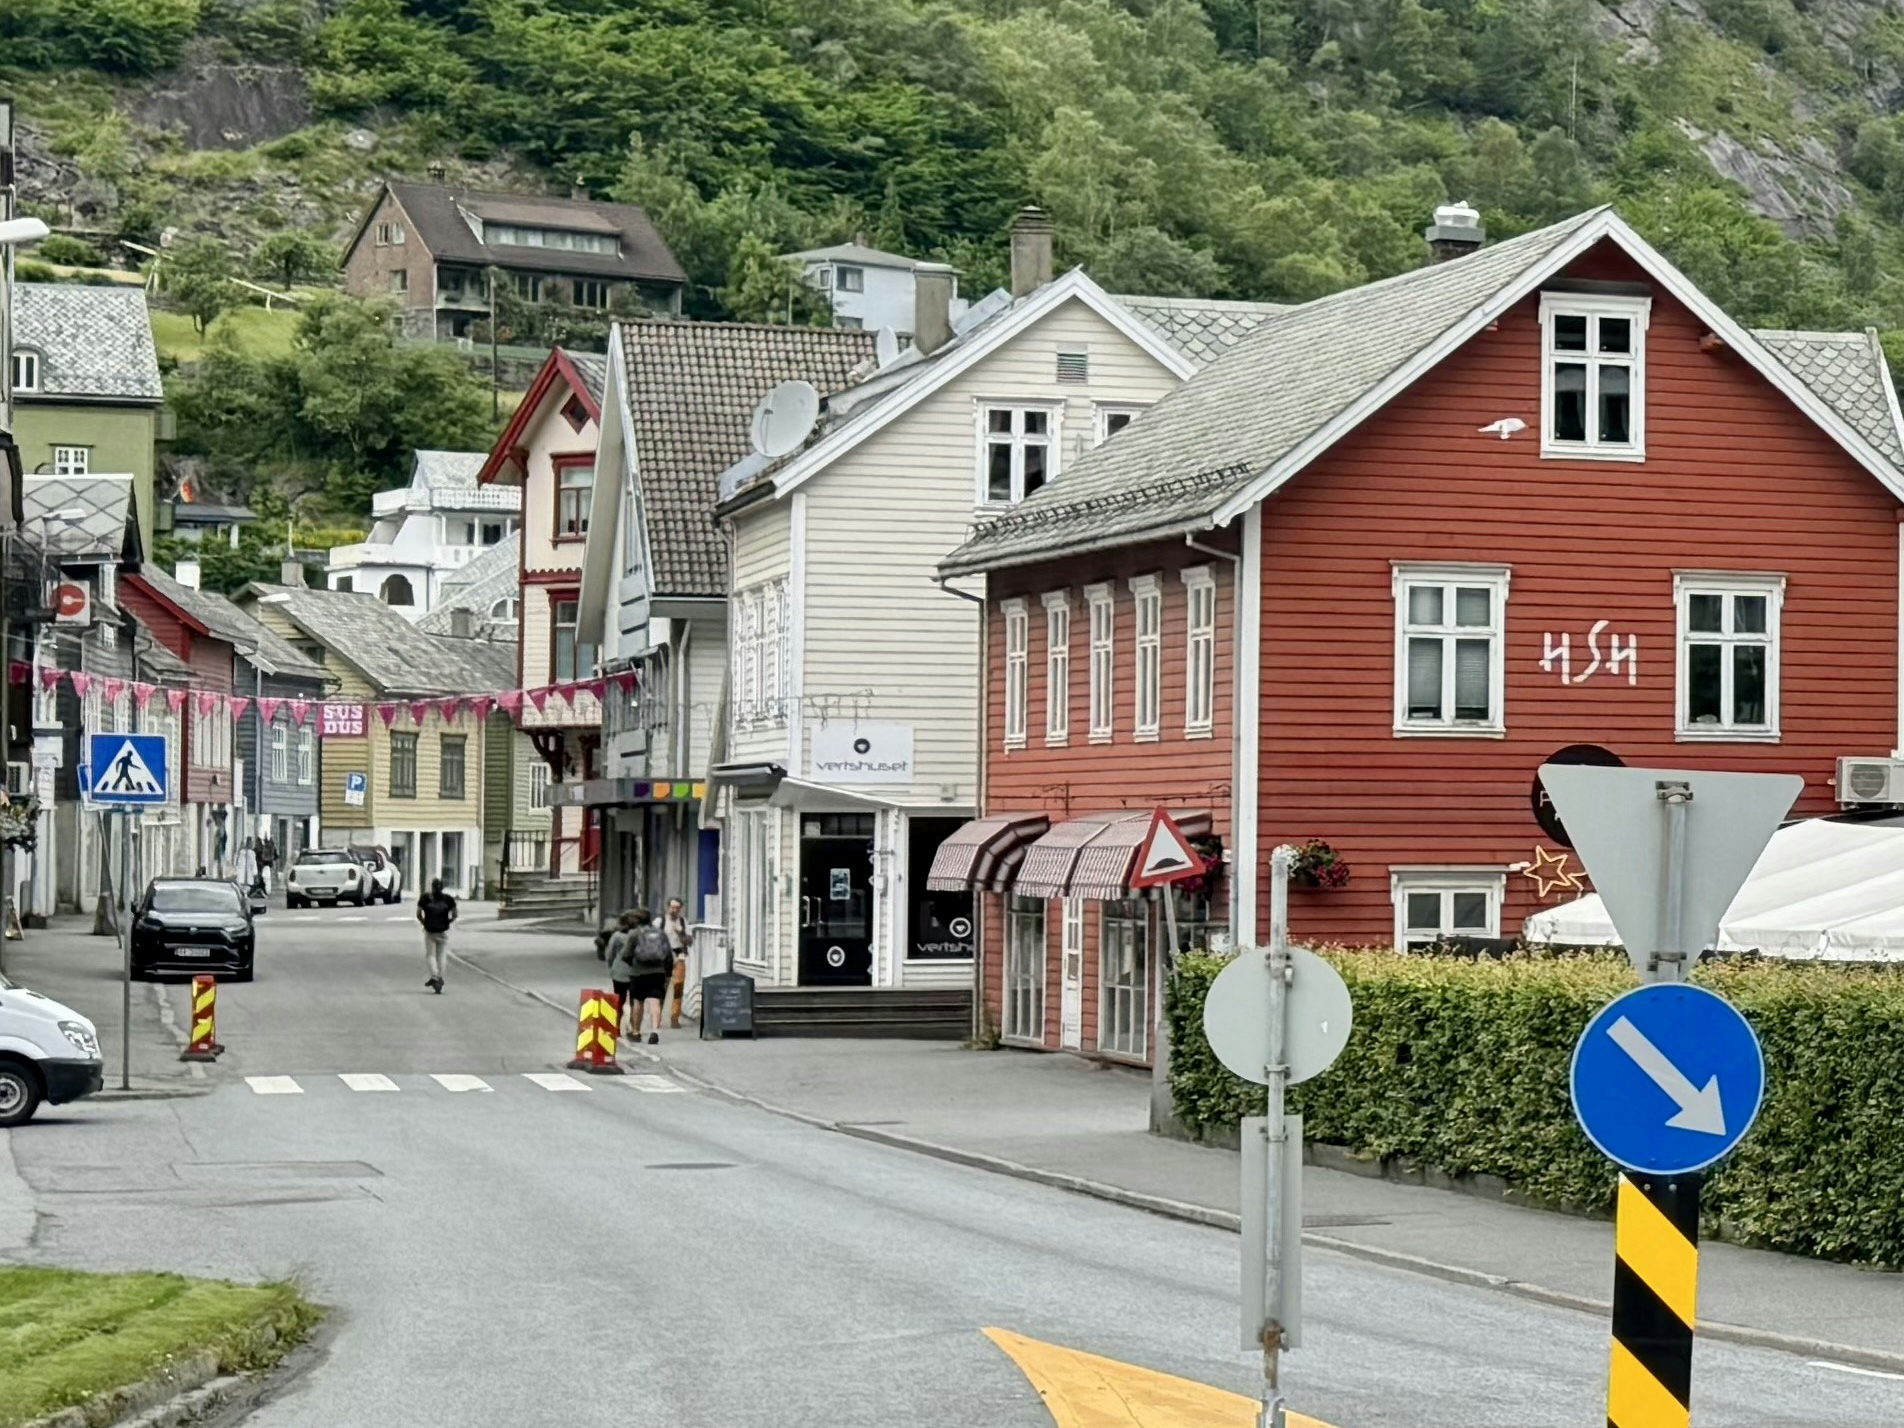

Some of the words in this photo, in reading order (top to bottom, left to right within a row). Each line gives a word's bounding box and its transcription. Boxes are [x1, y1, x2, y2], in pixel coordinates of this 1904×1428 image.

[1538, 620, 1637, 685] HSH
[323, 704, 363, 719] SUS
[323, 721, 363, 734] DUS
[815, 760, 908, 771] vertshuset
